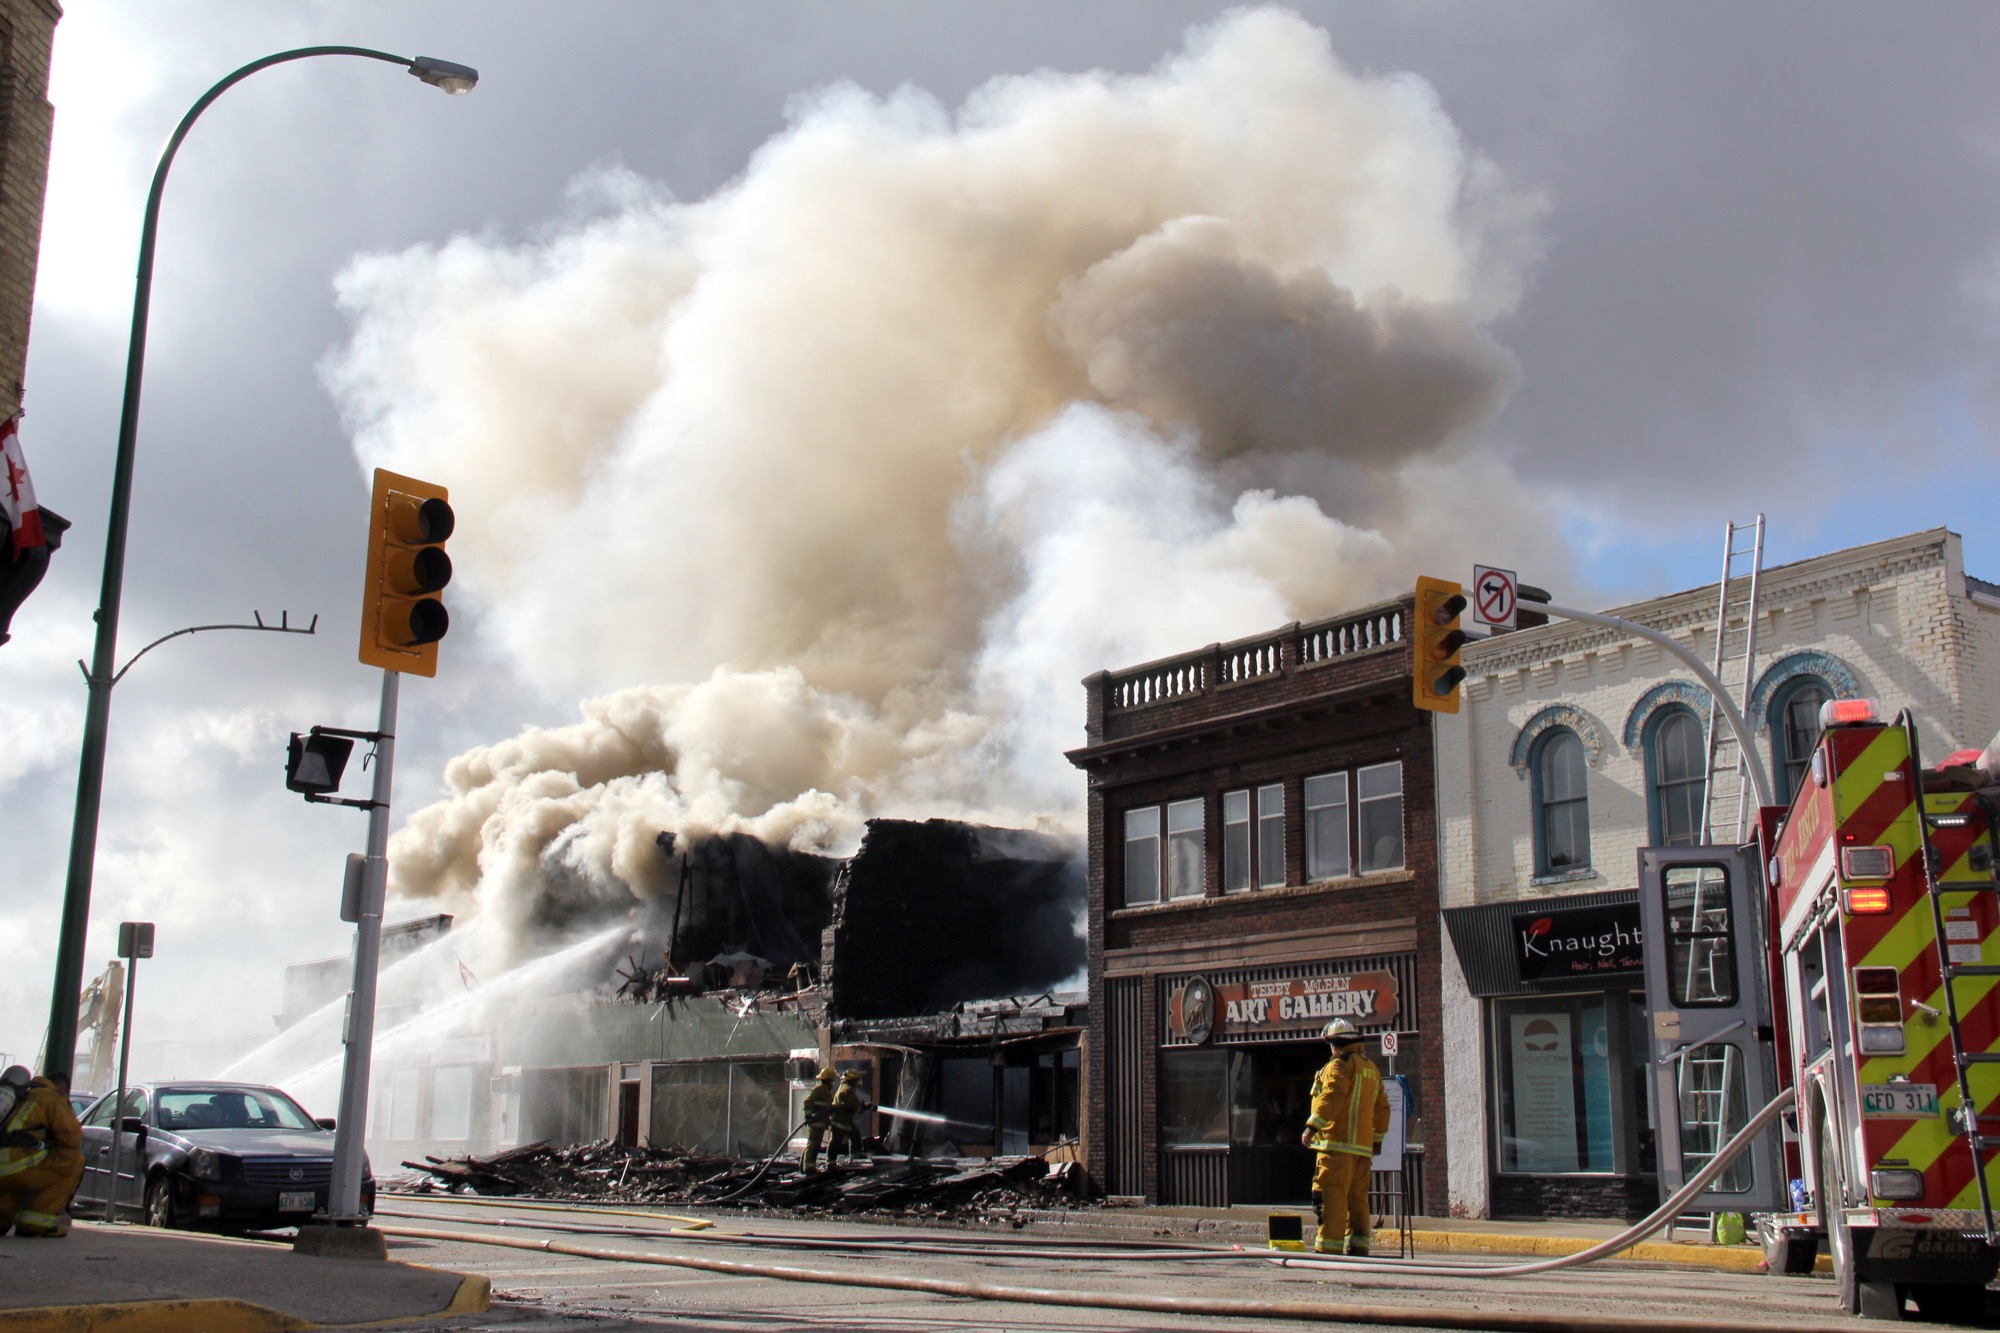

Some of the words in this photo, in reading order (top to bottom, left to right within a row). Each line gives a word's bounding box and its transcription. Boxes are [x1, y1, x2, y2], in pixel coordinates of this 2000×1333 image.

[1251, 982, 1291, 997] TERRY
[1303, 977, 1350, 994] McLEAN
[1225, 998, 1269, 1024] ART
[1279, 989, 1376, 1020] GALLERY
[1866, 1092, 1895, 1109] CFD
[1905, 1092, 1933, 1109] 311
